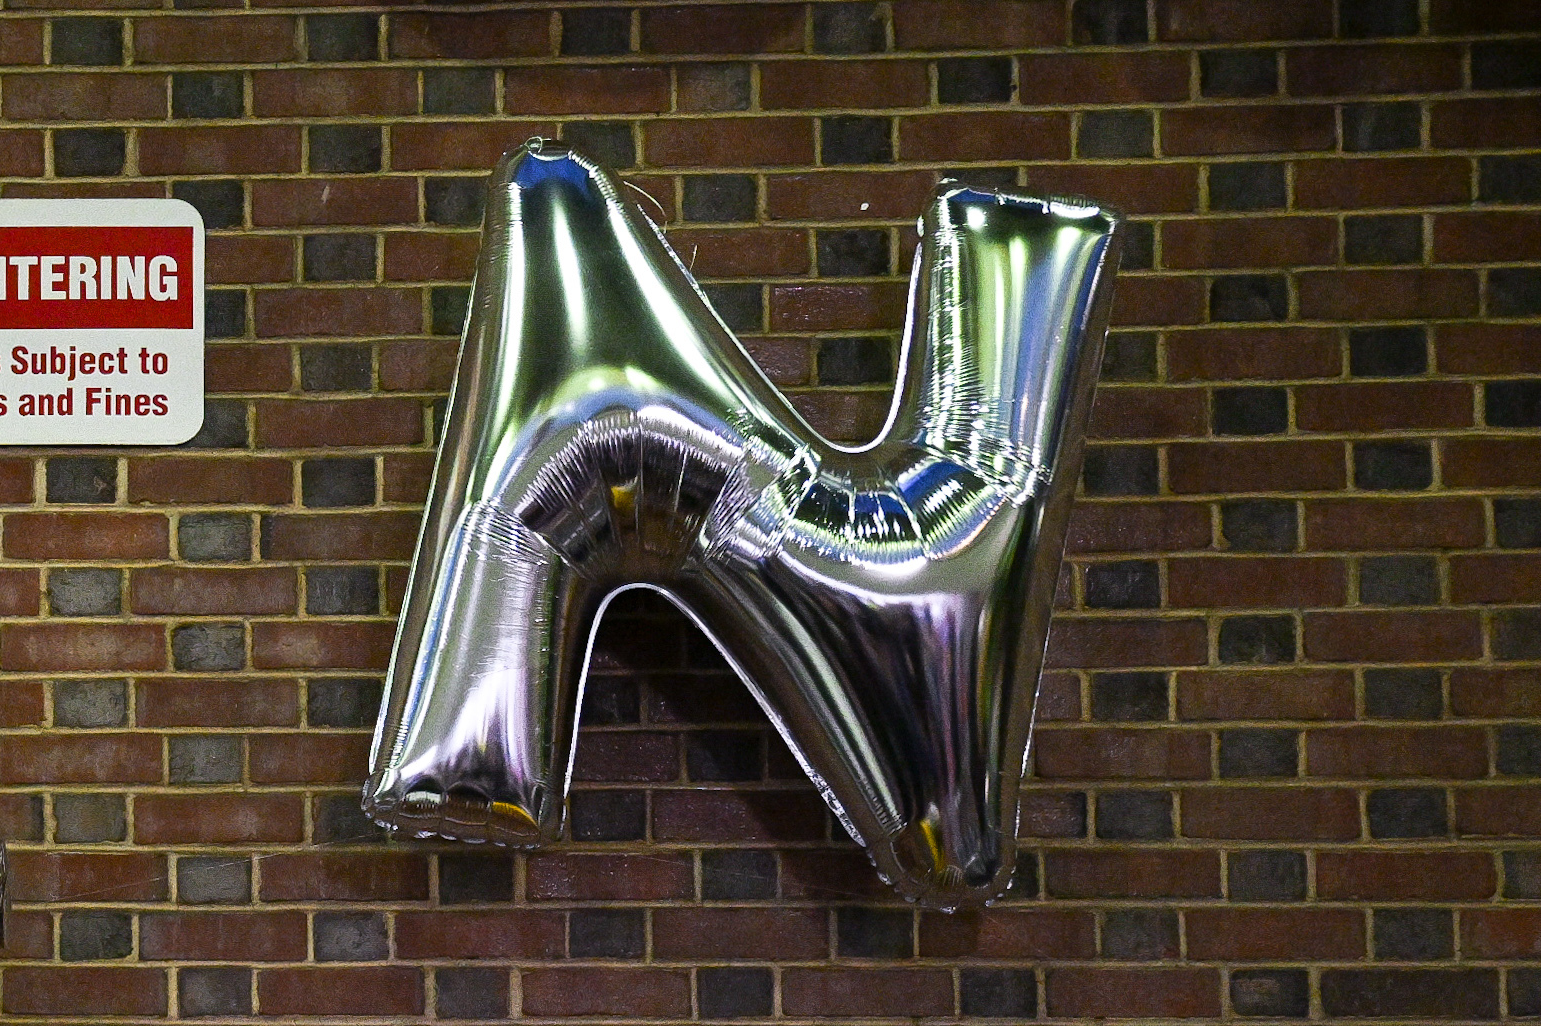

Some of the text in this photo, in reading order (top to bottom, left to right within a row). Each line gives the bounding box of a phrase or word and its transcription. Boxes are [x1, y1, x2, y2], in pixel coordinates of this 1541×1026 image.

[9, 344, 129, 382] Subject
[137, 346, 170, 376] to
[17, 386, 75, 418] and
[84, 386, 170, 417] Fines
